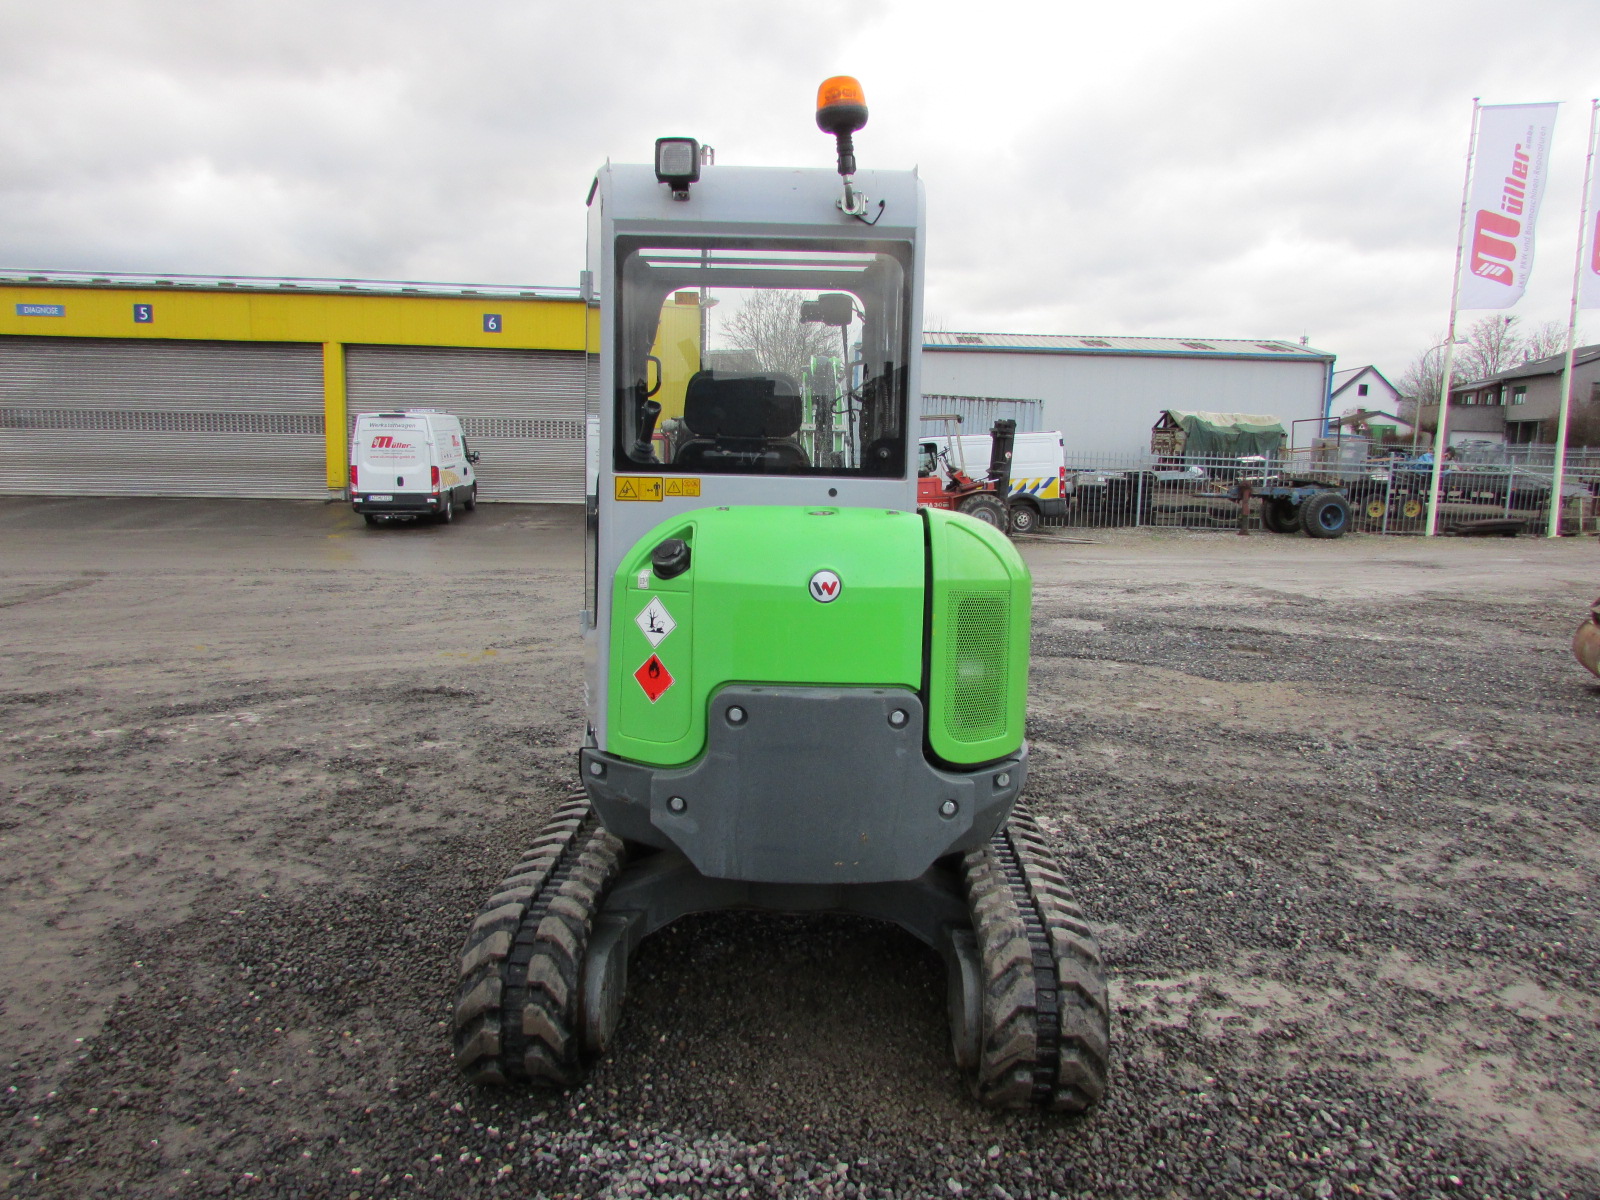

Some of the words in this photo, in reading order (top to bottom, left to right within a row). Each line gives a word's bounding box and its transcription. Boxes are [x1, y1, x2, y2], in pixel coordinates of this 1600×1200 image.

[23, 305, 59, 315] DIAGNOSE
[138, 306, 149, 321] 5
[488, 316, 497, 330] 6
